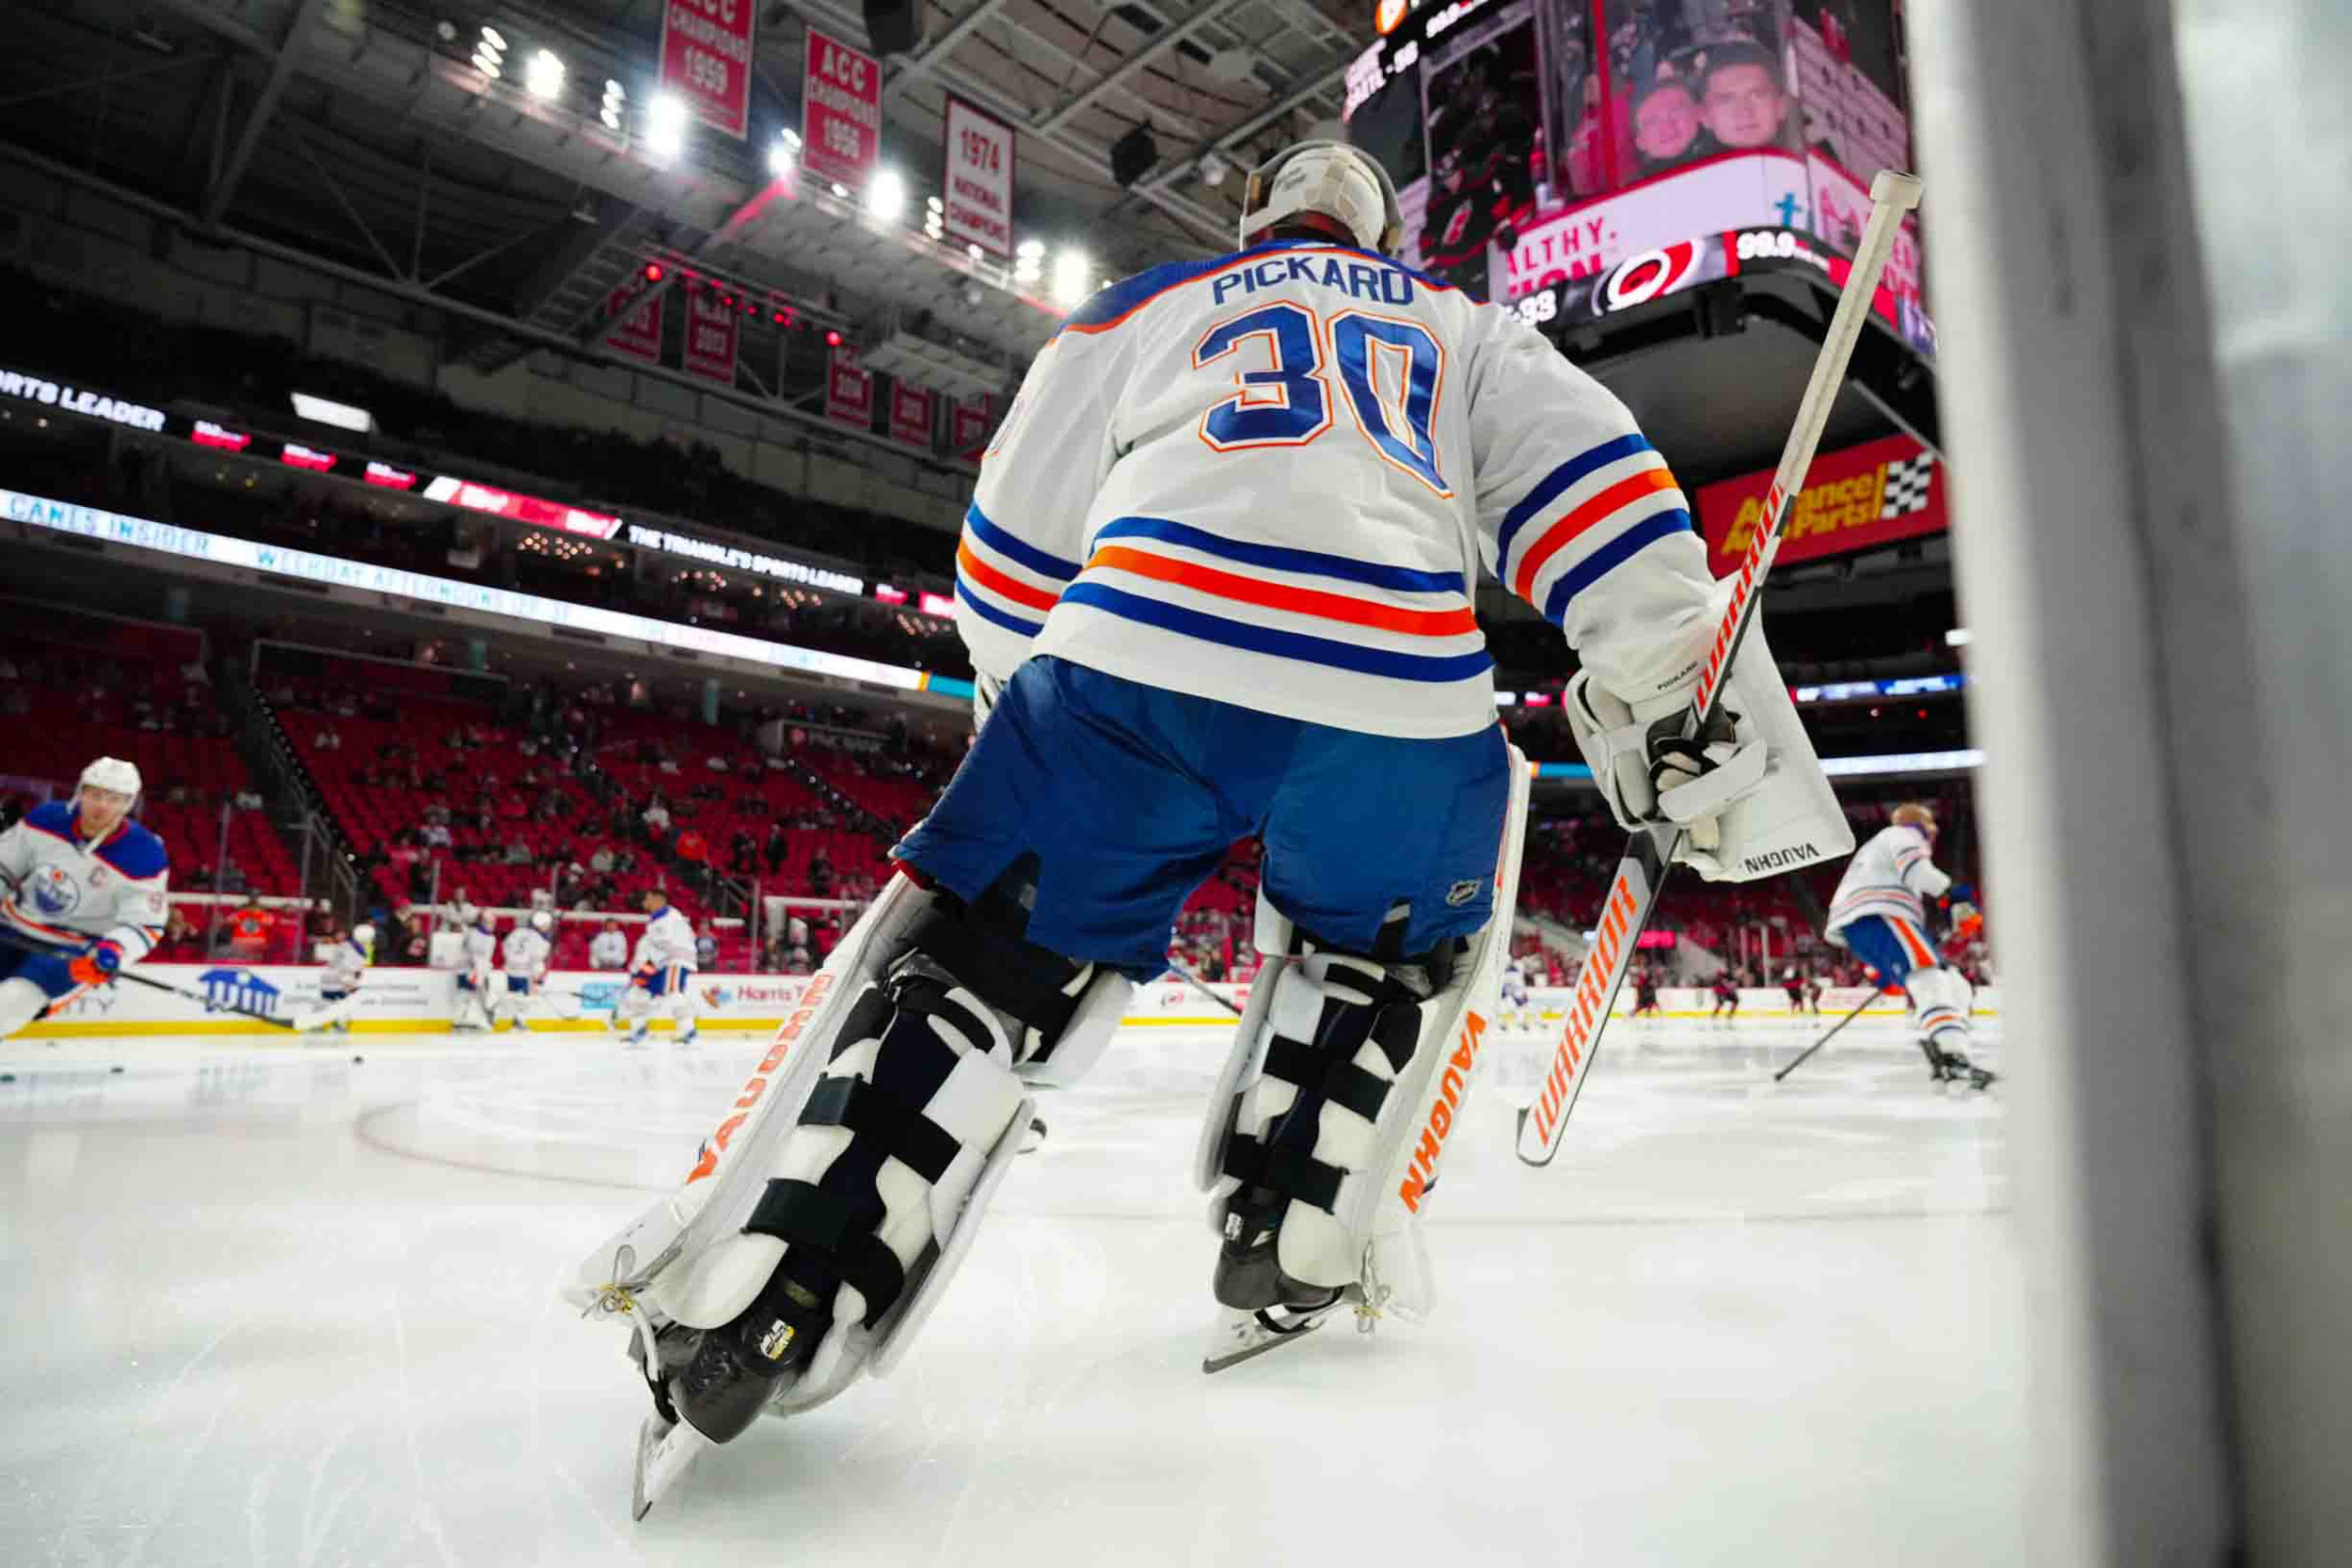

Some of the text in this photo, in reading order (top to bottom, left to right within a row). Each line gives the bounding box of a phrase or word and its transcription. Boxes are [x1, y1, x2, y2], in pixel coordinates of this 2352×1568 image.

[821, 45, 866, 92] ACC
[960, 128, 1000, 176] 1974
[1212, 256, 1415, 307] PICKARD
[59, 386, 167, 433] LEADER
[1192, 299, 1455, 499] 30
[1696, 482, 1785, 712] WARRIO
[1744, 842, 1820, 873] VAUGHN
[738, 985, 792, 1000] Harris
[1534, 874, 1638, 1149] WARRIOR
[1399, 1010, 1487, 1213] VAUGHN
